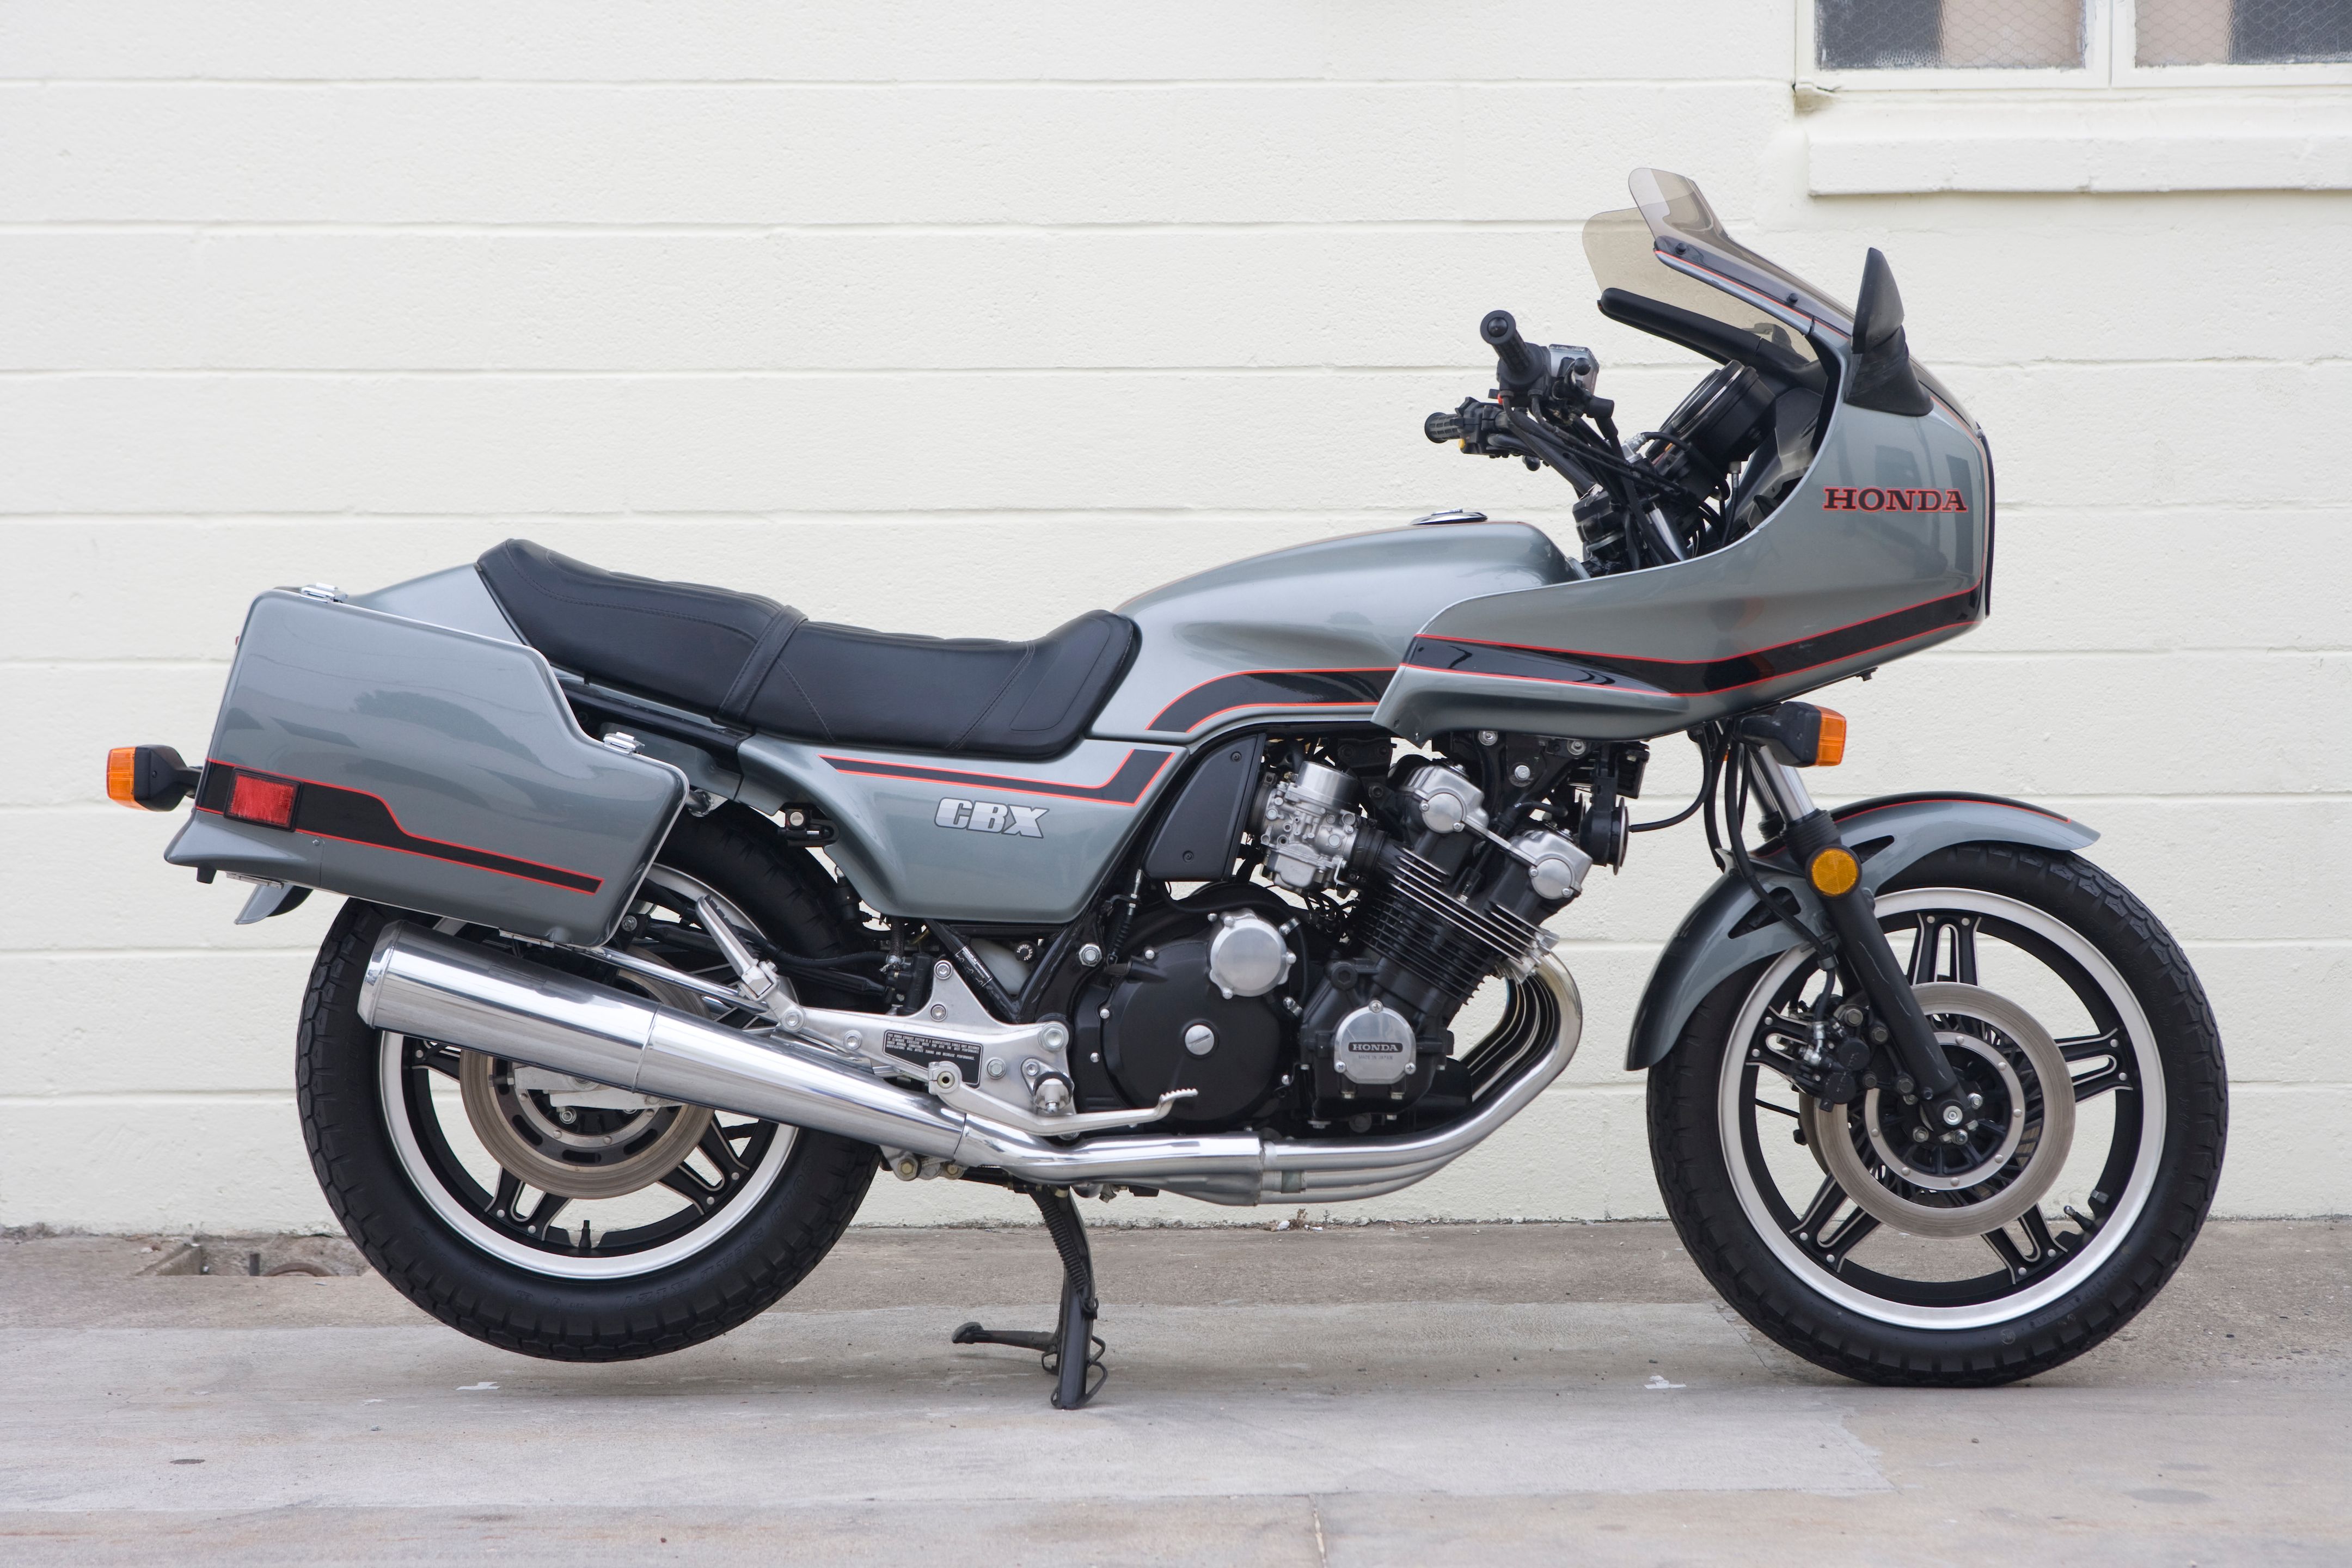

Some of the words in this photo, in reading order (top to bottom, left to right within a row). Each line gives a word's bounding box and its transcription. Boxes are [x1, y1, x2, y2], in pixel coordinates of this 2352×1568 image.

[1822, 486, 1967, 513] HONDA
[934, 797, 1050, 839] CBX
[1352, 1043, 1398, 1051] HONDA
